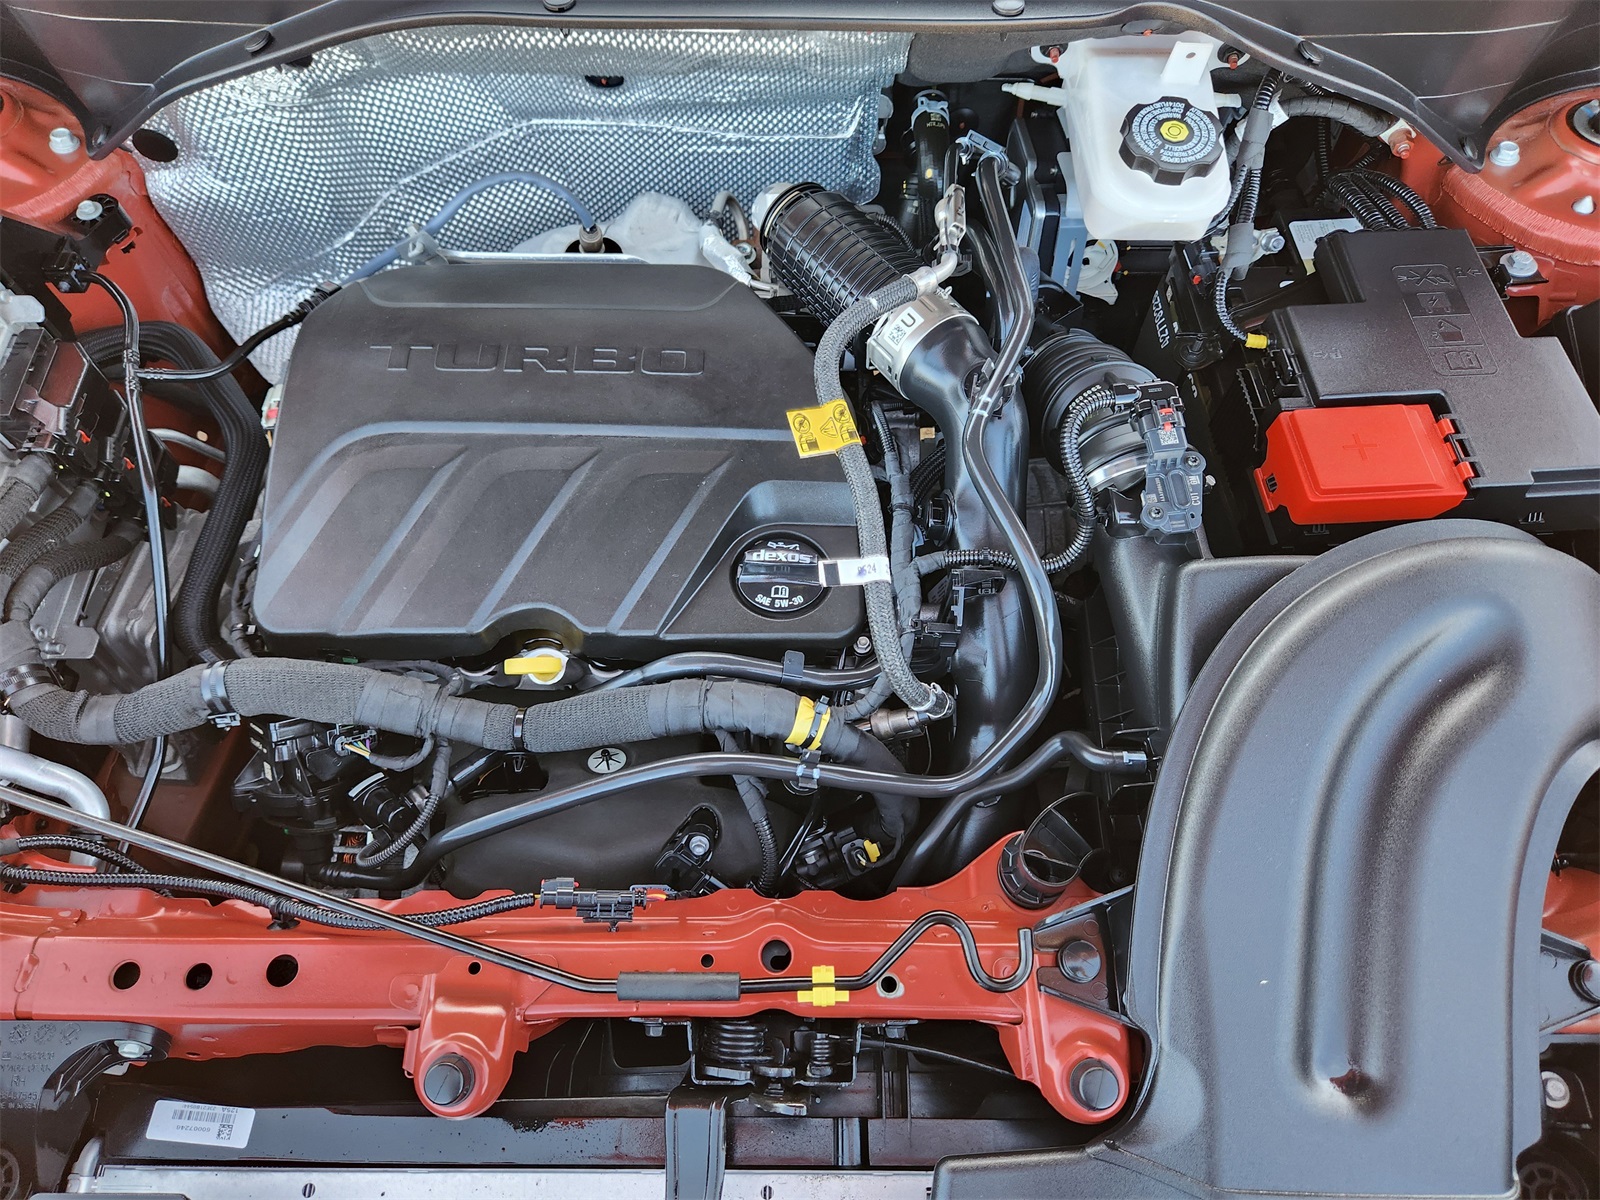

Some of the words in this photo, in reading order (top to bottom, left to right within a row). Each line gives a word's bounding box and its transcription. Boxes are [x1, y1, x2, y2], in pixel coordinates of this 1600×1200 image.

[369, 342, 706, 376] TURBO
[752, 549, 813, 564] dexos
[754, 593, 771, 607] SAE
[774, 595, 804, 608] 5W-30
